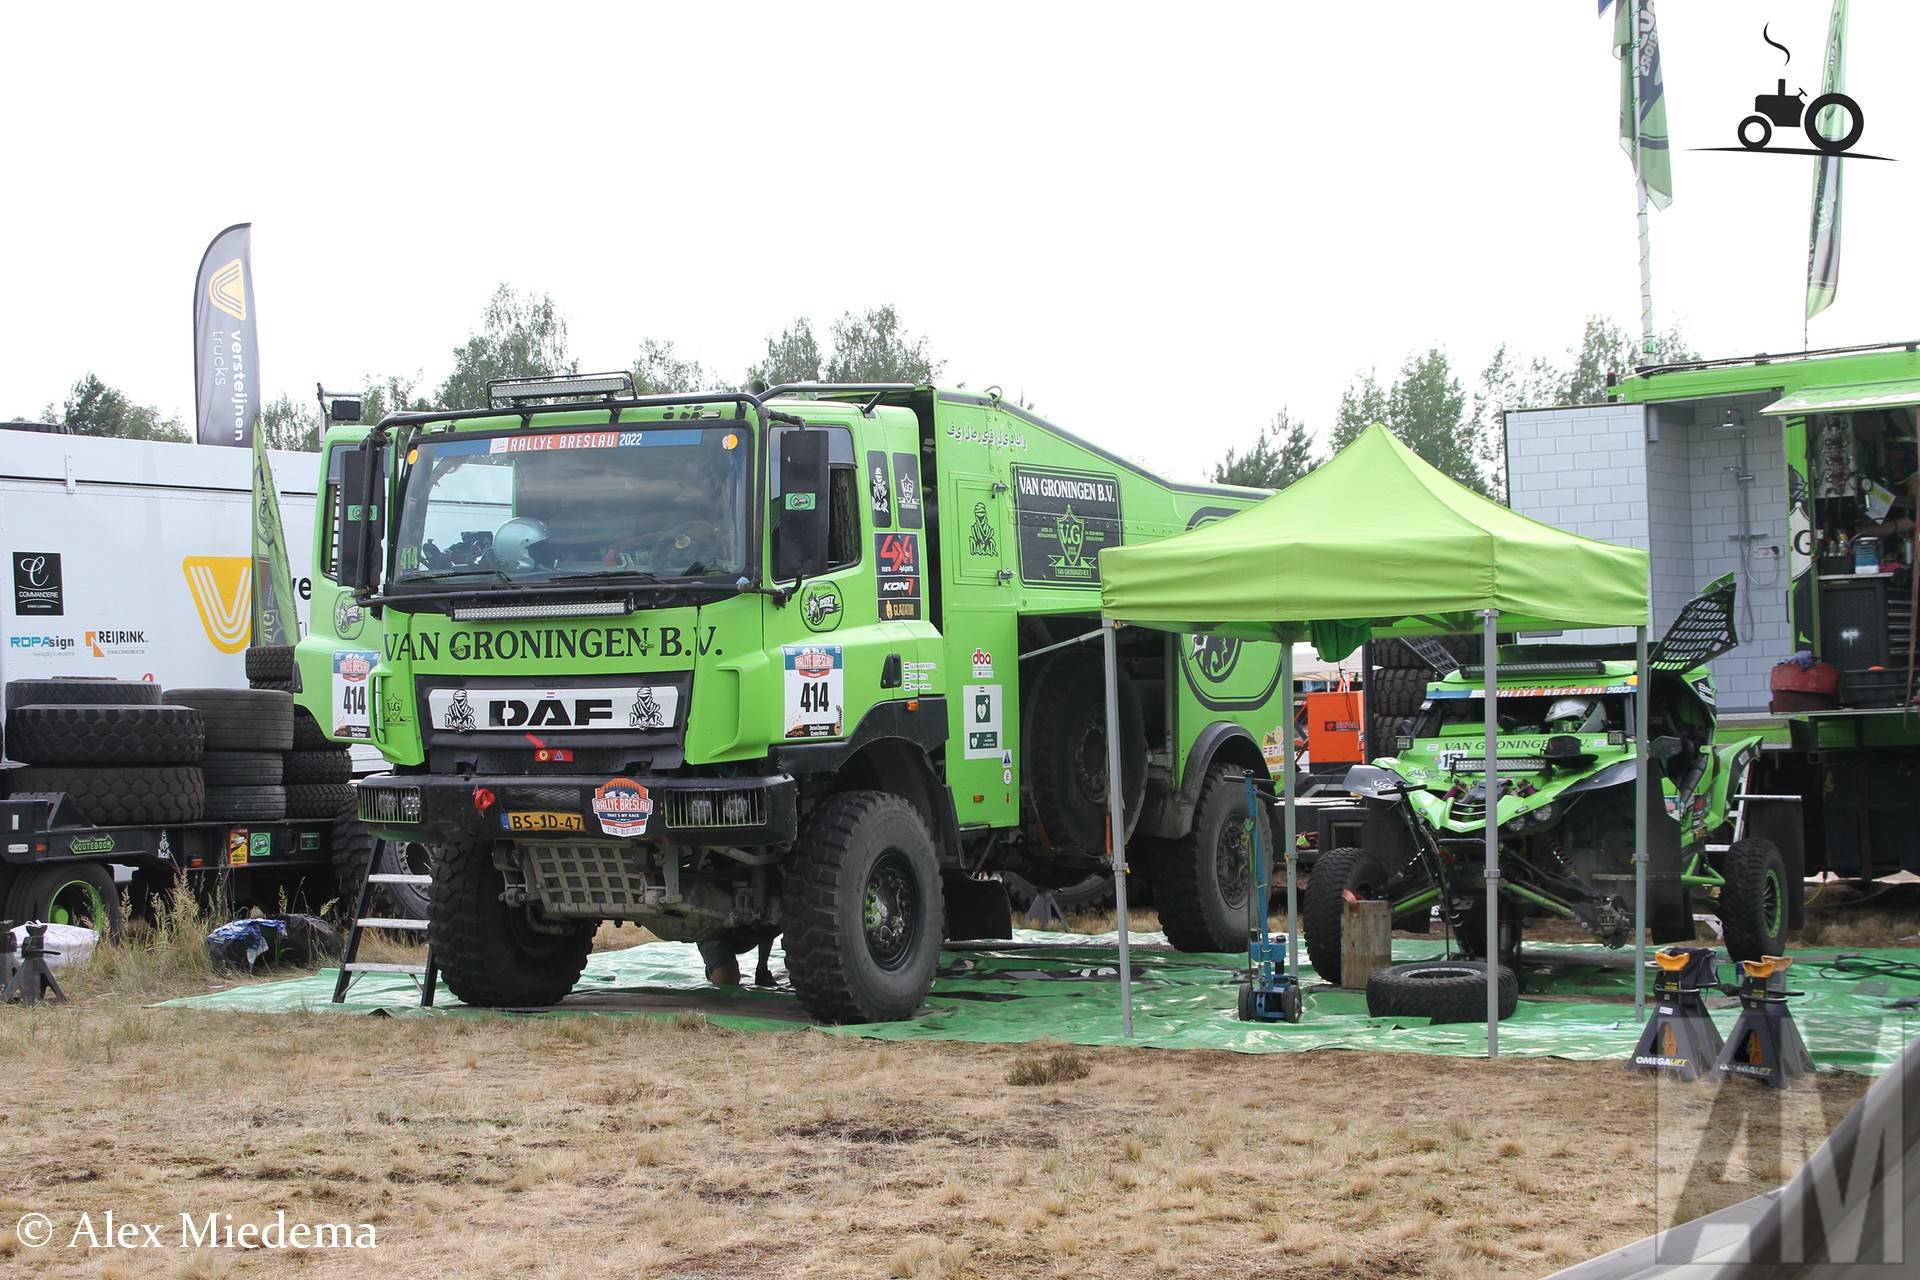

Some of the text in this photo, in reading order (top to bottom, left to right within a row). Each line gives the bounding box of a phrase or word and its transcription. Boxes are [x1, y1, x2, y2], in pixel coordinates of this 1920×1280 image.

[212, 330, 228, 387] trucks
[231, 330, 247, 442] versteijnen
[510, 432, 642, 451] RALLYE BRESLAU 2022
[1019, 475, 1116, 503] VAN GRONINGEN B.V.
[883, 581, 909, 591] KONI
[98, 630, 145, 645] REIJRINK
[383, 625, 723, 662] VAN GRONINGEN B.V.
[973, 649, 992, 665] dba
[343, 686, 366, 715] 414
[800, 682, 829, 713] 414
[445, 713, 477, 729] DAKAR
[489, 699, 613, 727] DAF
[629, 711, 664, 728] DAKAR
[1445, 742, 1471, 750] VAN
[595, 798, 650, 812] RALLYE BRESLAU
[510, 812, 582, 831] BS-JD-47
[73, 841, 112, 851] NOOTEBOOM
[1635, 1055, 1688, 1067] OMEGALIFT
